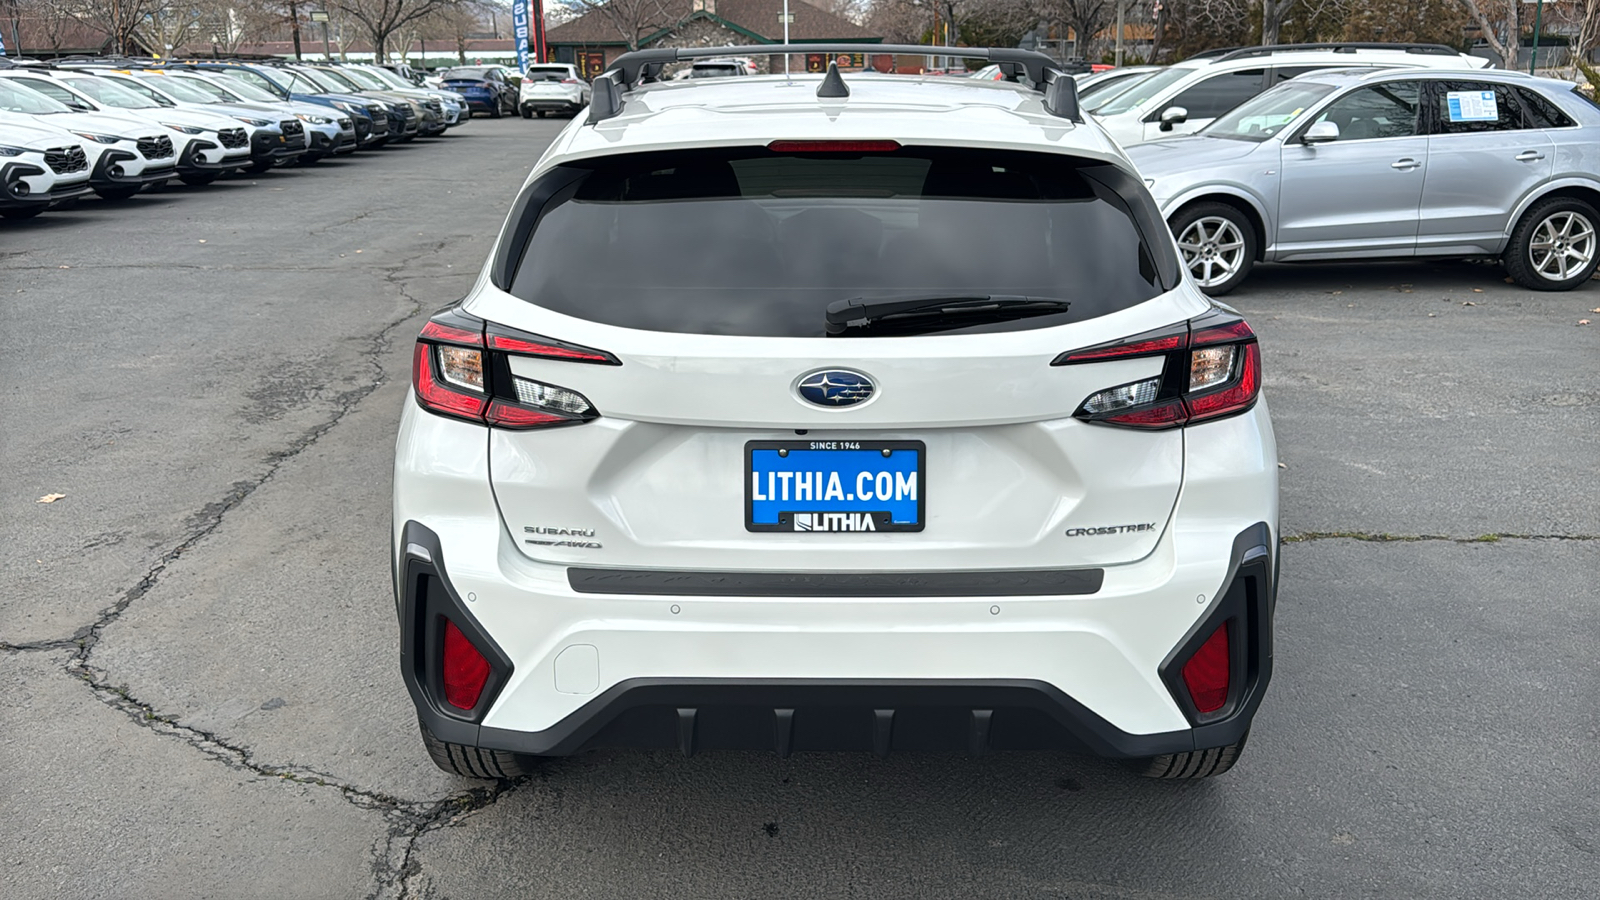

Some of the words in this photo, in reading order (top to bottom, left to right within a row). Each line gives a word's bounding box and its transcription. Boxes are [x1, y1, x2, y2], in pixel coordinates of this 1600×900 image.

[810, 442, 837, 450] SINCE
[840, 442, 860, 450] 1946
[752, 470, 918, 502] LITHIA.COM
[812, 513, 876, 531] LITHIA
[523, 526, 596, 537] SUBARU
[1065, 522, 1156, 537] CROSSTREK
[553, 540, 603, 549] AWD
